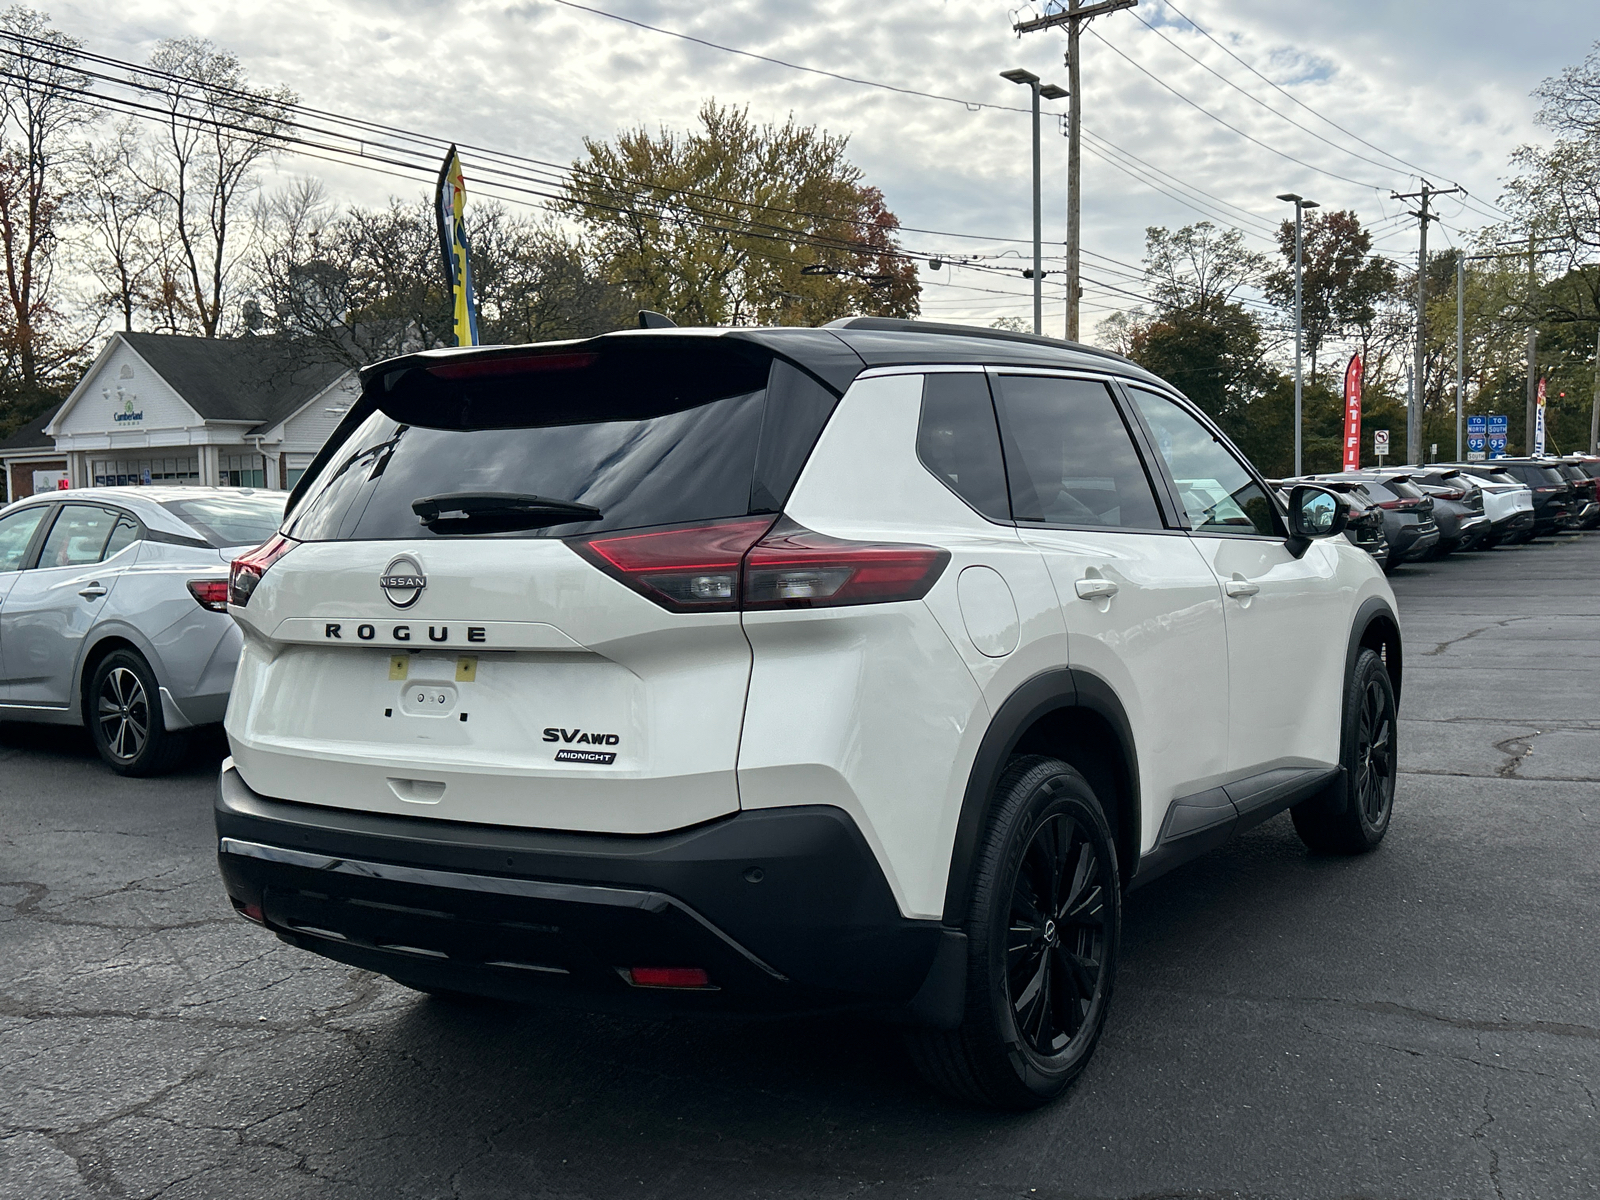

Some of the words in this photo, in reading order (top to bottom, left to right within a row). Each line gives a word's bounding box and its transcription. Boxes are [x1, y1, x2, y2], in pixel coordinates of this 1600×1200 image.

[114, 411, 143, 421] Cumberland
[1470, 440, 1483, 448] 95
[1491, 440, 1504, 448] 95
[381, 577, 425, 587] NISSAN
[325, 623, 486, 643] ROGUE
[557, 752, 612, 762] MIDNIGHT
